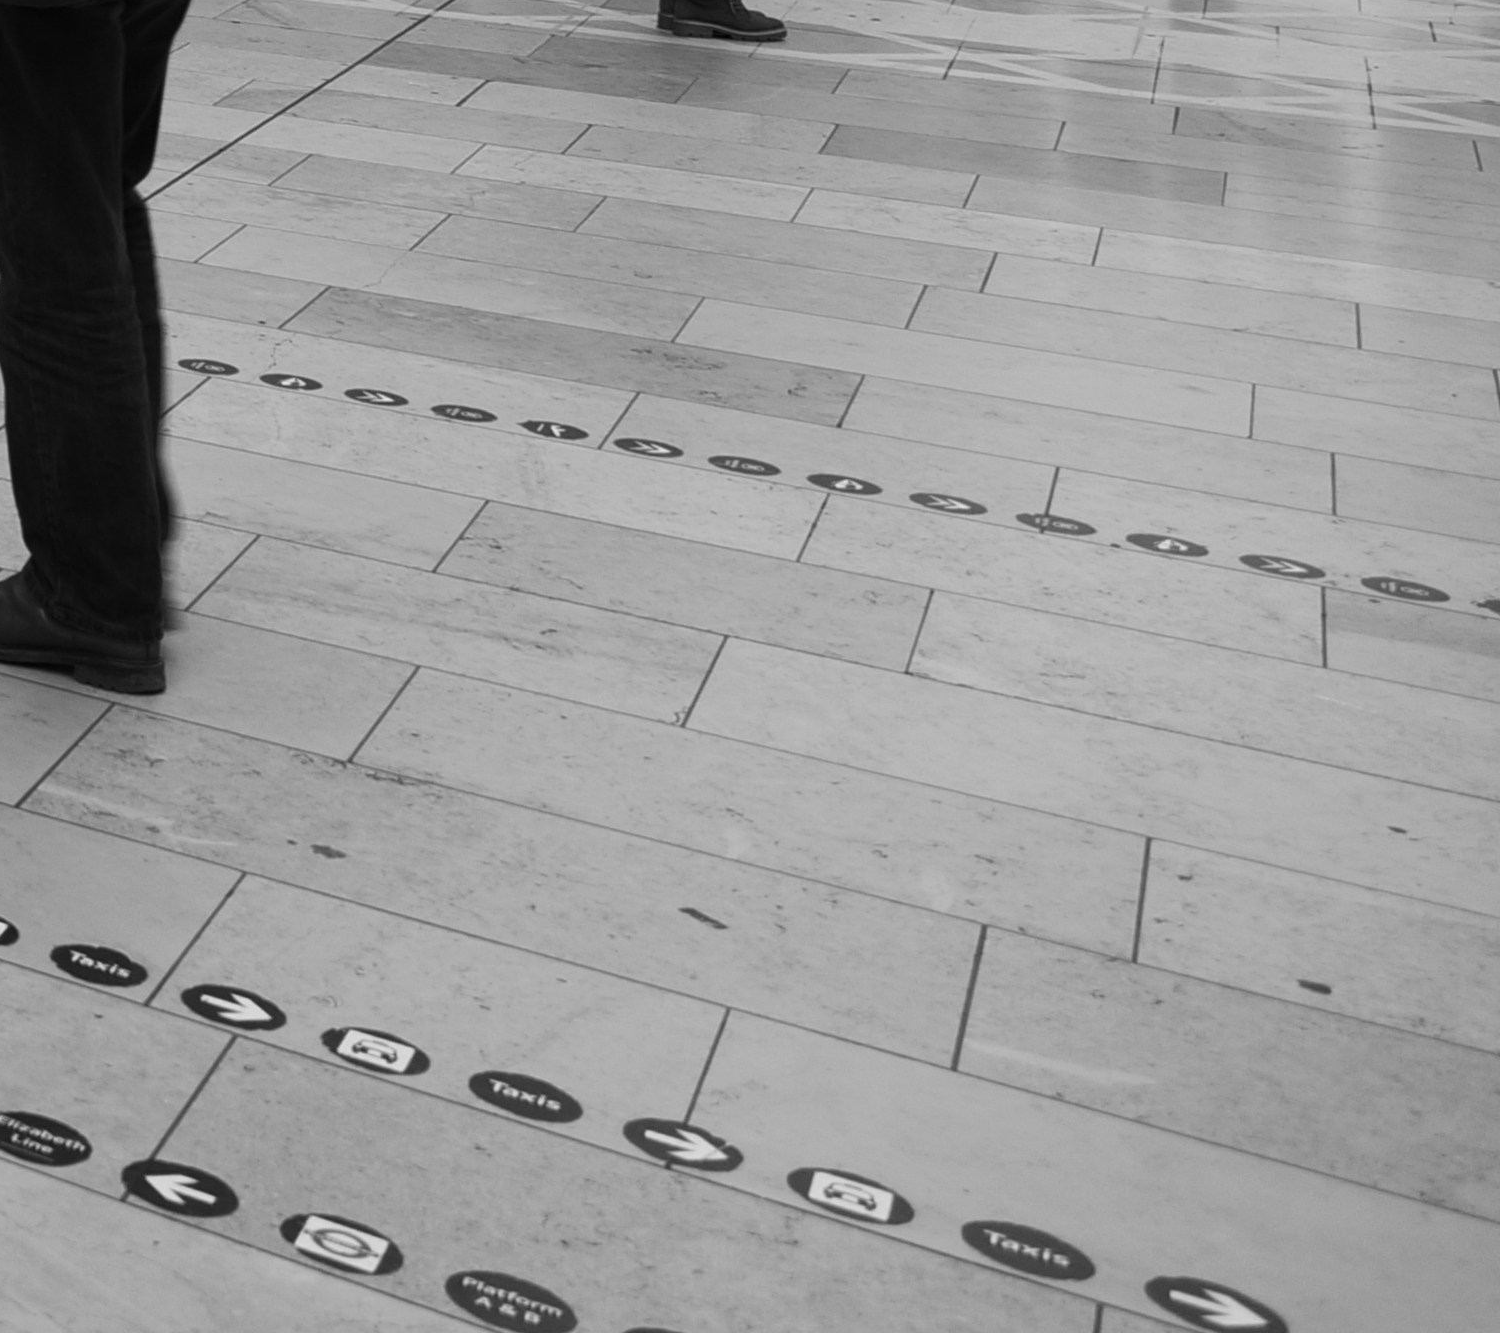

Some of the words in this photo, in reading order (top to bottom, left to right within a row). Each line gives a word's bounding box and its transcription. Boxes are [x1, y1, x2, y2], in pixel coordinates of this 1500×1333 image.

[70, 950, 130, 978] Taxis
[489, 1078, 561, 1111] Taxis
[9, 1133, 54, 1155] Line
[983, 1229, 1070, 1267] Taxis
[461, 1275, 563, 1319] Platform
[474, 1294, 493, 1310] A
[498, 1302, 518, 1318] &
[523, 1310, 542, 1326] B
